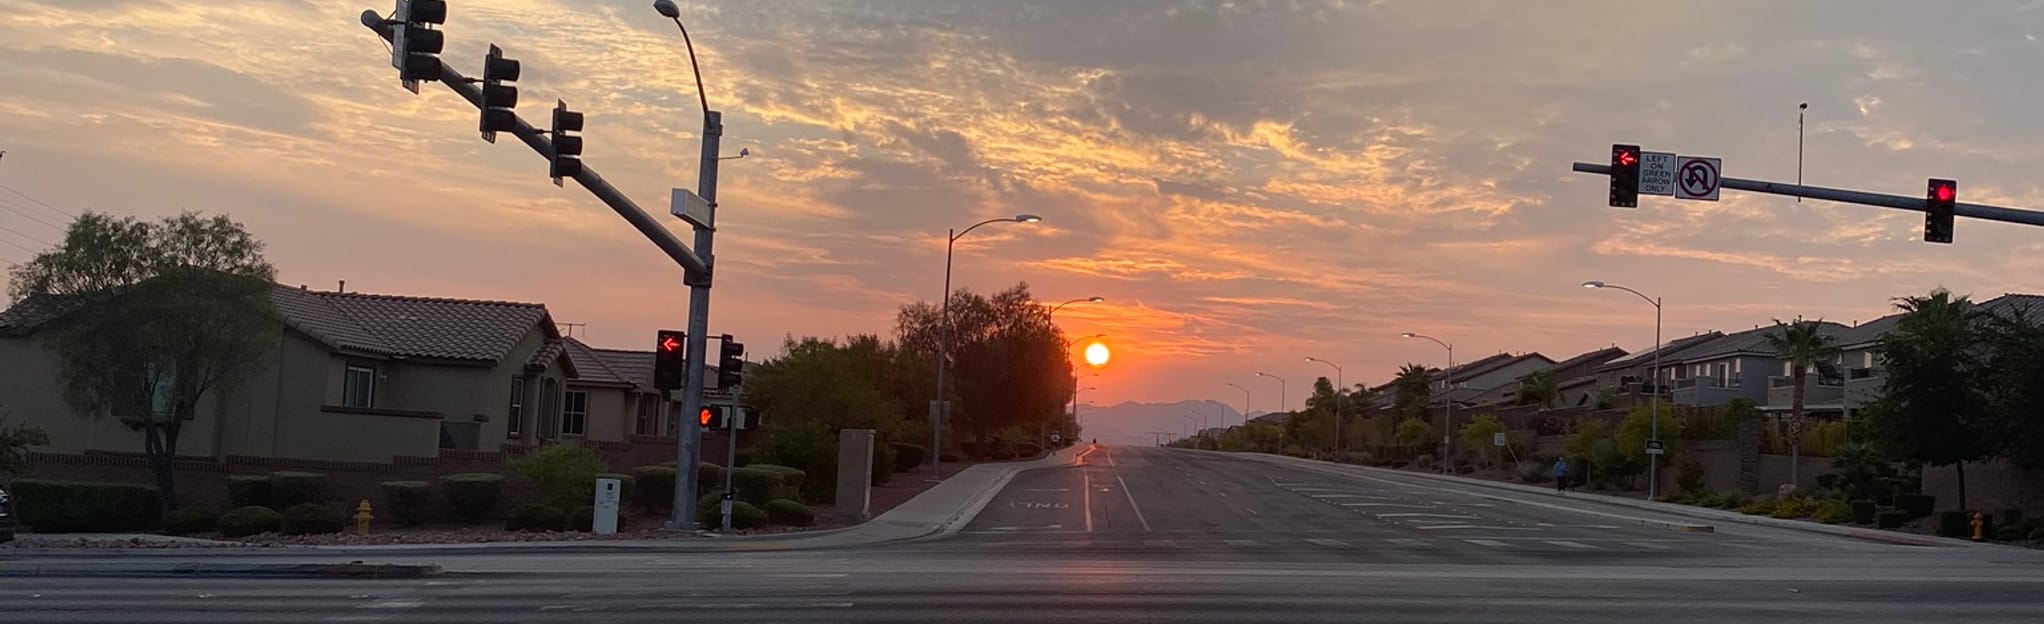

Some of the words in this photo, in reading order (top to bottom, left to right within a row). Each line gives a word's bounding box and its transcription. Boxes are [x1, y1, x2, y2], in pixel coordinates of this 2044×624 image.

[1643, 169, 1671, 178] GREEN
[1641, 177, 1670, 185] ARROW
[1645, 184, 1665, 192] ONLY
